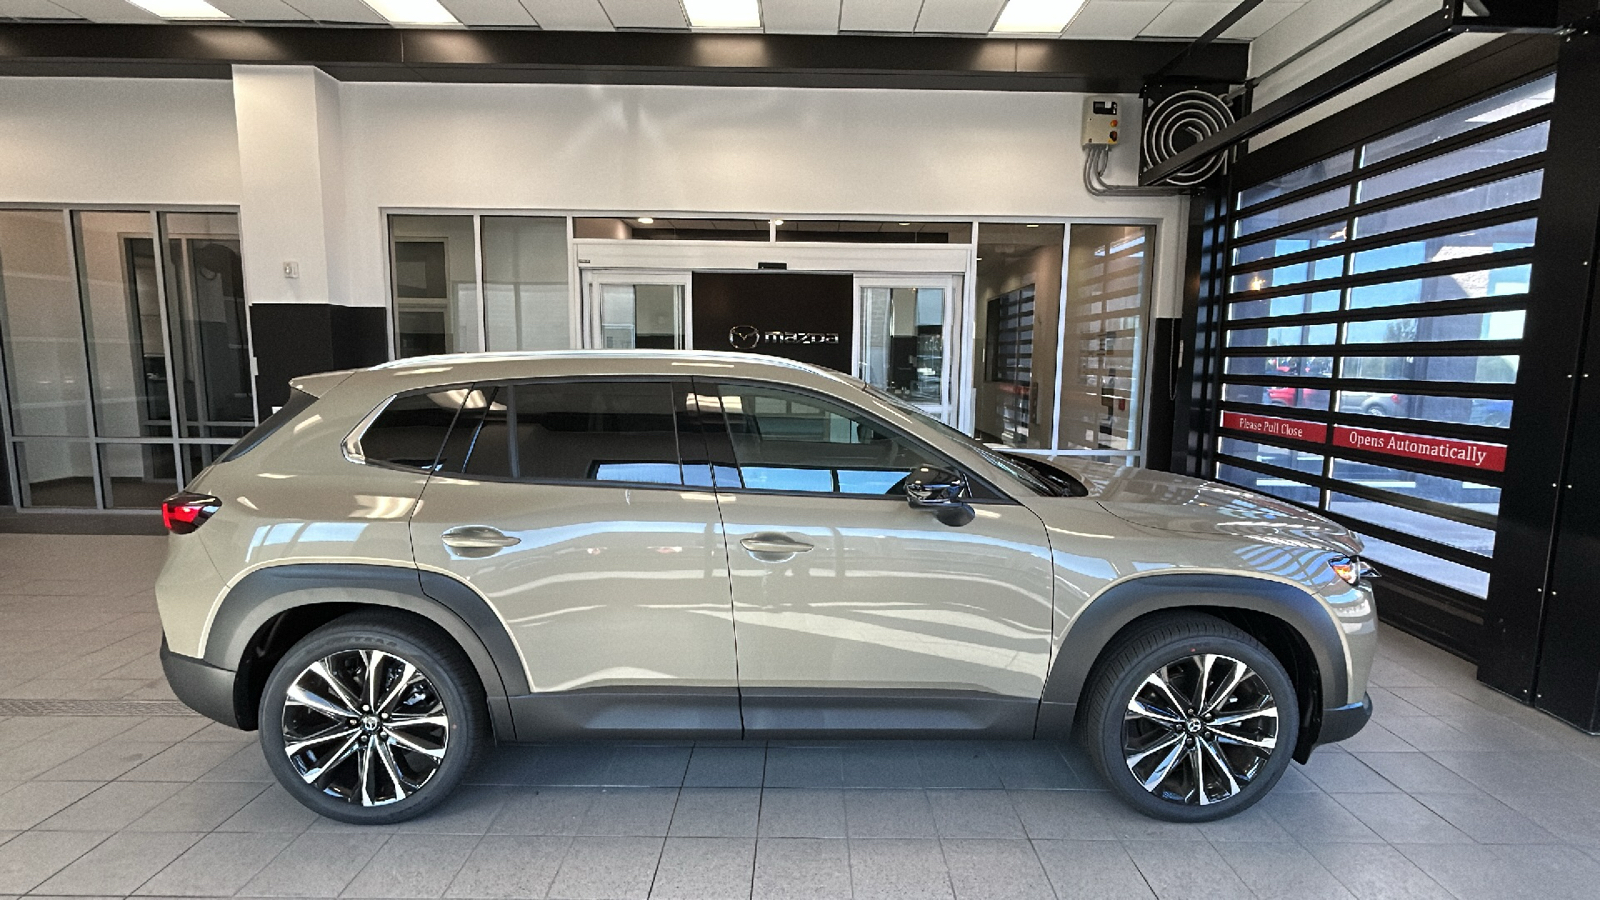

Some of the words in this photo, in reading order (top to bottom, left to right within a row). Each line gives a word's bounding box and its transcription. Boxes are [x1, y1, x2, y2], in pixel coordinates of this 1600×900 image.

[1239, 417, 1262, 431] Please
[1263, 421, 1279, 434] Pull
[1281, 423, 1303, 437] Close
[1349, 431, 1384, 448] Opens
[1387, 436, 1487, 466] Automatically
